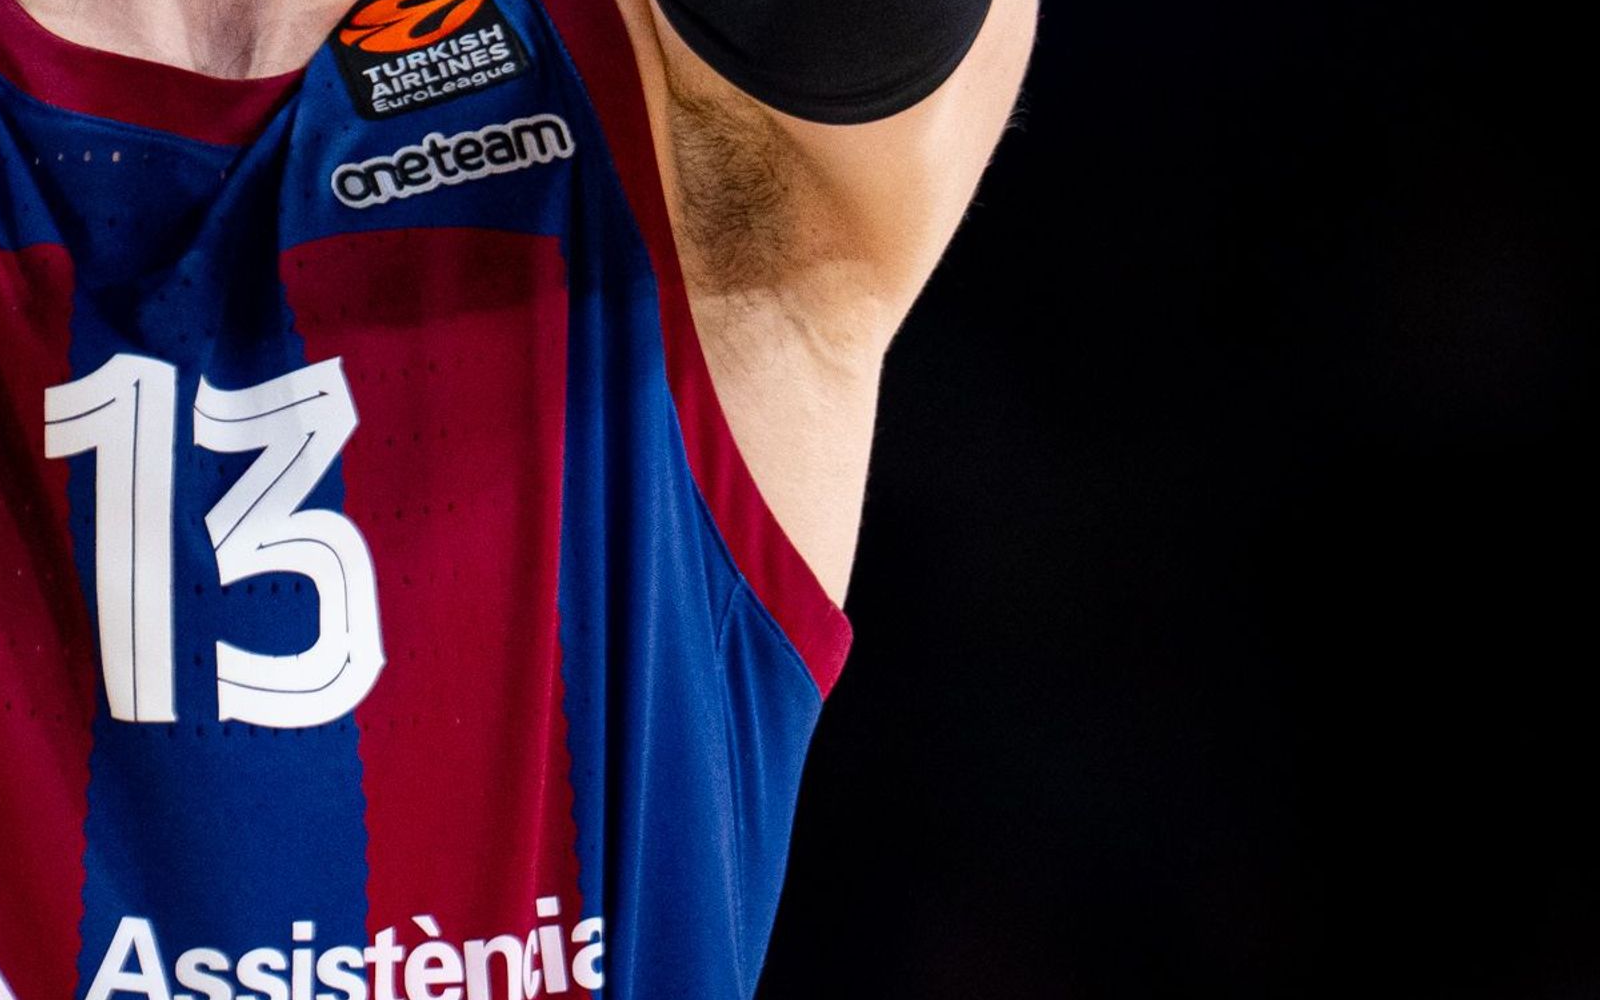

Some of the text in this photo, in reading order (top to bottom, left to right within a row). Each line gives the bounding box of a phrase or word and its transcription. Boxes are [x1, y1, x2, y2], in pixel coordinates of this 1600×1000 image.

[362, 23, 504, 83] TURKISH
[371, 42, 511, 100] AIRLINES
[373, 61, 516, 113] EuroLeague
[334, 119, 568, 202] oneteam
[44, 353, 387, 729] 13
